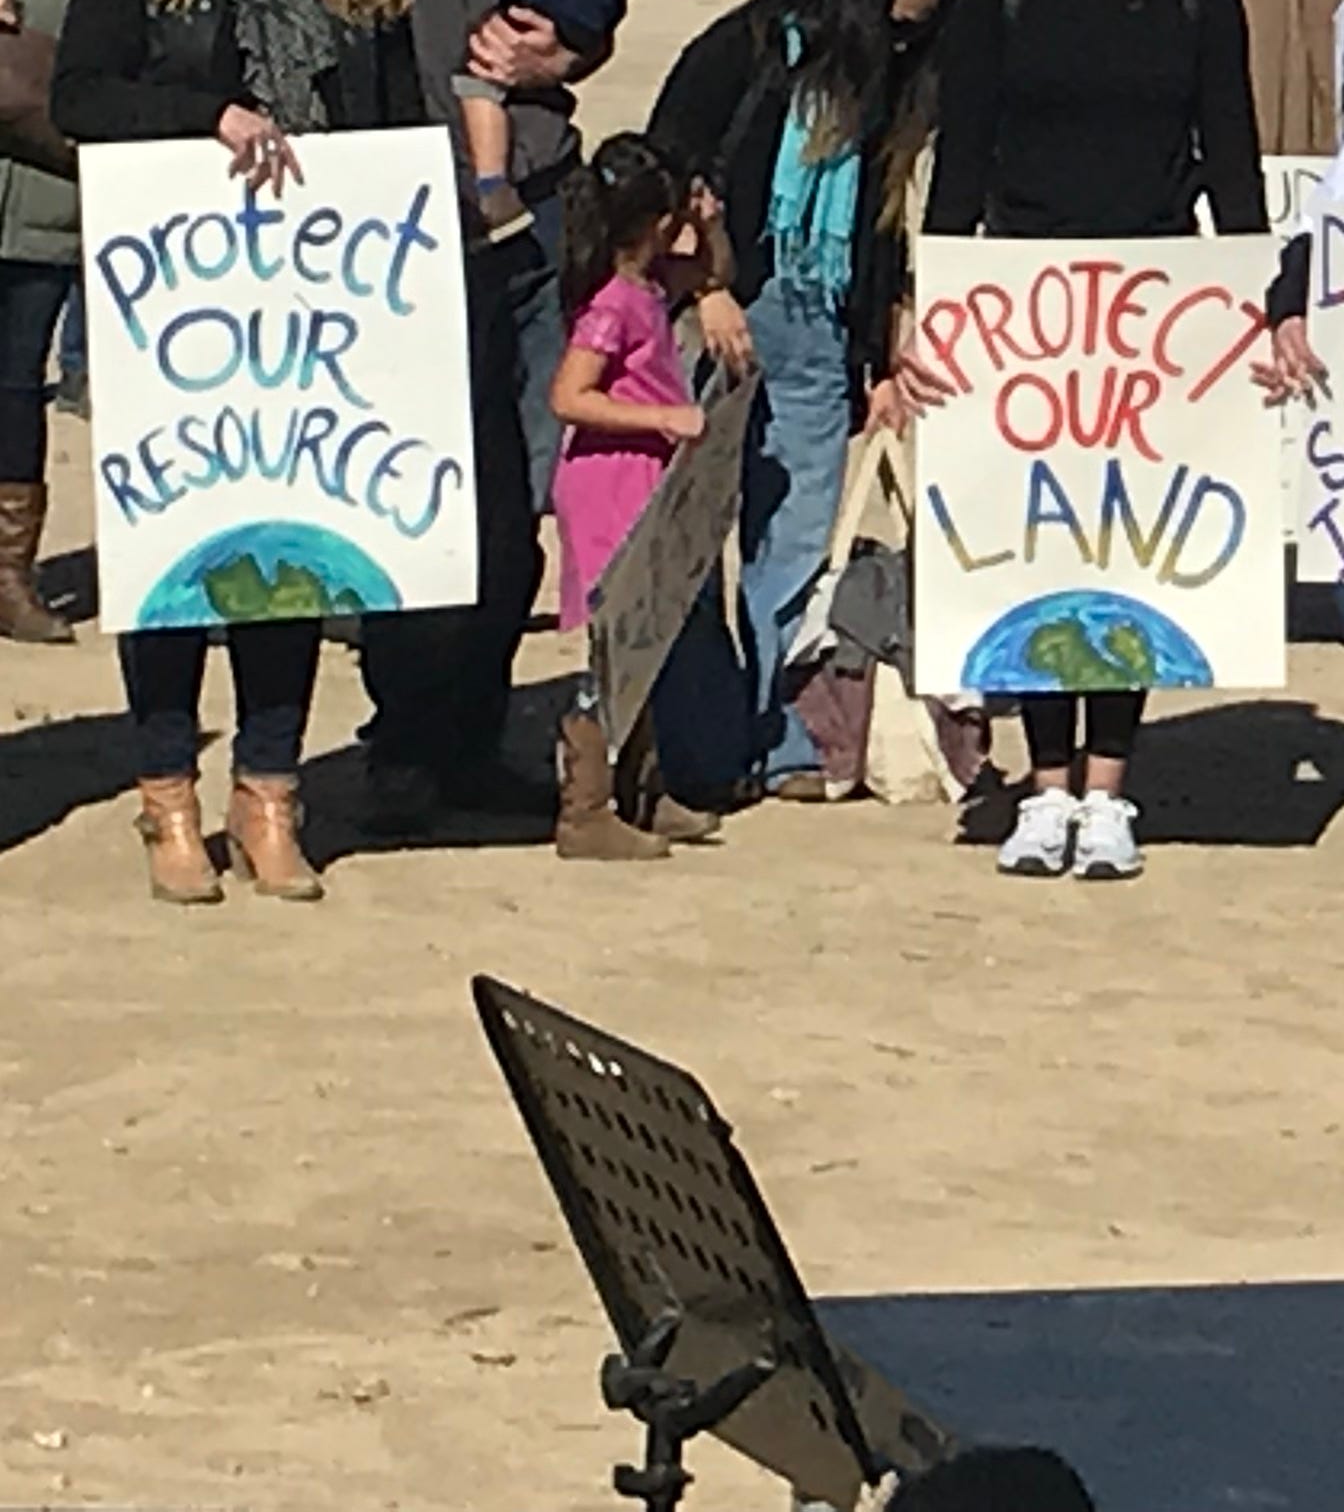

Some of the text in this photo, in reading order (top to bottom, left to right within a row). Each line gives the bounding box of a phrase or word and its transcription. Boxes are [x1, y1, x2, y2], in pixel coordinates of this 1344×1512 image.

[95, 179, 438, 350] protect
[157, 308, 374, 409] OUR
[921, 261, 1270, 402] PROTECT
[100, 406, 464, 539] RESOURCES
[995, 366, 1163, 461] OUR
[927, 458, 1246, 588] LAND
